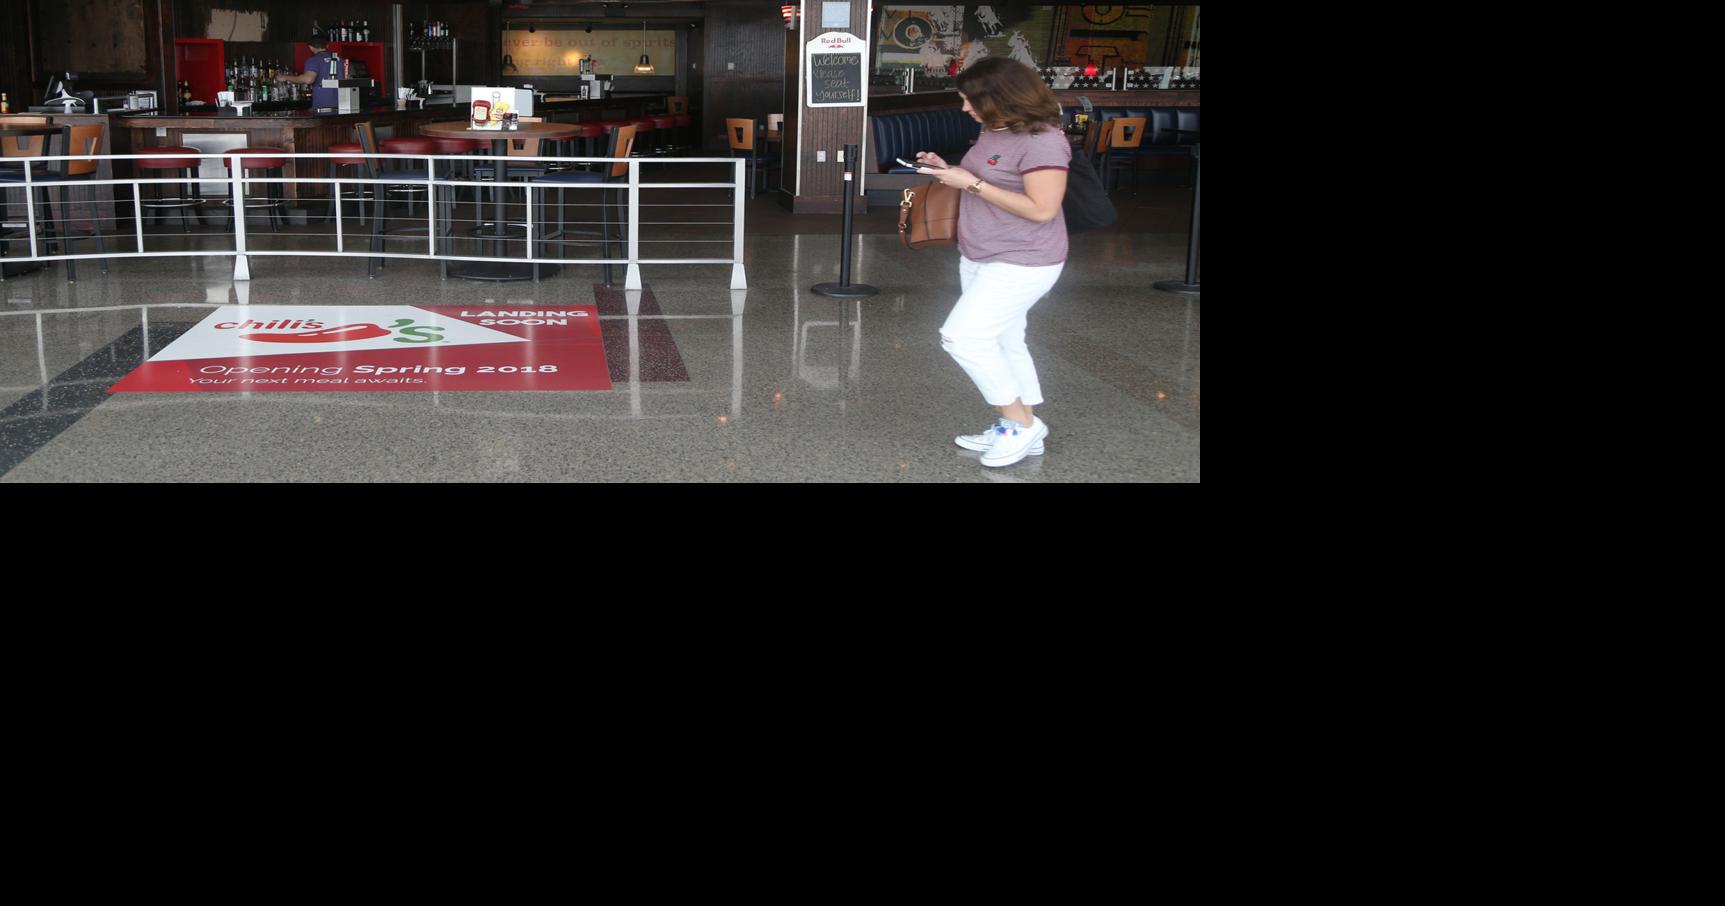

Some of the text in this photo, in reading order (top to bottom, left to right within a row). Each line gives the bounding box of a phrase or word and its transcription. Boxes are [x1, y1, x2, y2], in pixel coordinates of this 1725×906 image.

[544, 36, 562, 48] be
[567, 37, 597, 48] out
[601, 36, 620, 48] of
[812, 54, 860, 67] Welcome
[479, 318, 568, 326] SOON
[199, 364, 559, 376] Opening Spring 2018
